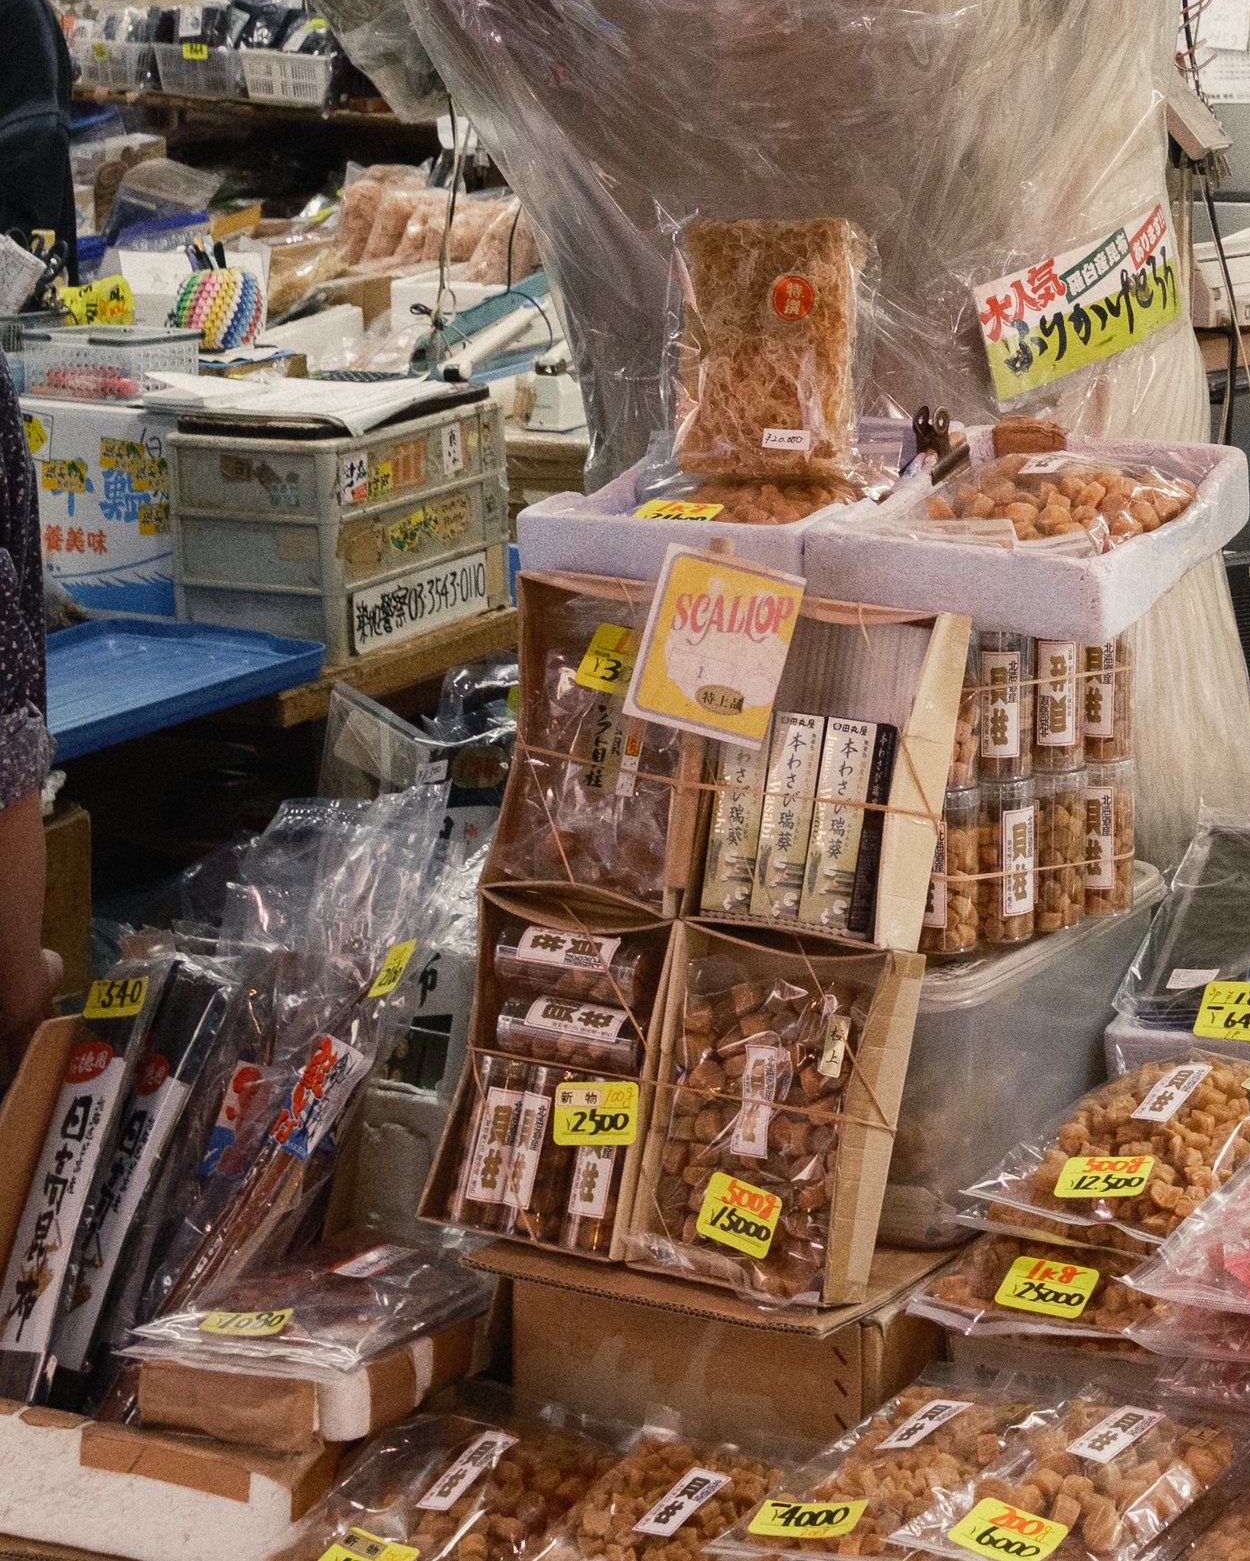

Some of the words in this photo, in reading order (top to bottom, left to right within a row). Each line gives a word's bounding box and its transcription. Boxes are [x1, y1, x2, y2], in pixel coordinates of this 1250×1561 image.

[979, 257, 1067, 343] 大人気
[672, 593, 795, 646] SCALLOP
[990, 666, 1009, 746] 貝柱
[1012, 821, 1028, 902] 貝柱
[541, 1003, 615, 1029] 貝柱
[559, 1090, 599, 1104] 新物
[1149, 1070, 1195, 1113] 貝柱
[566, 1108, 630, 1136] ¥2500
[480, 1104, 514, 1191] 貝柱
[1087, 1412, 1146, 1452] 貝柱
[653, 1475, 708, 1524] 貝柱
[771, 1503, 850, 1528] ¥4000
